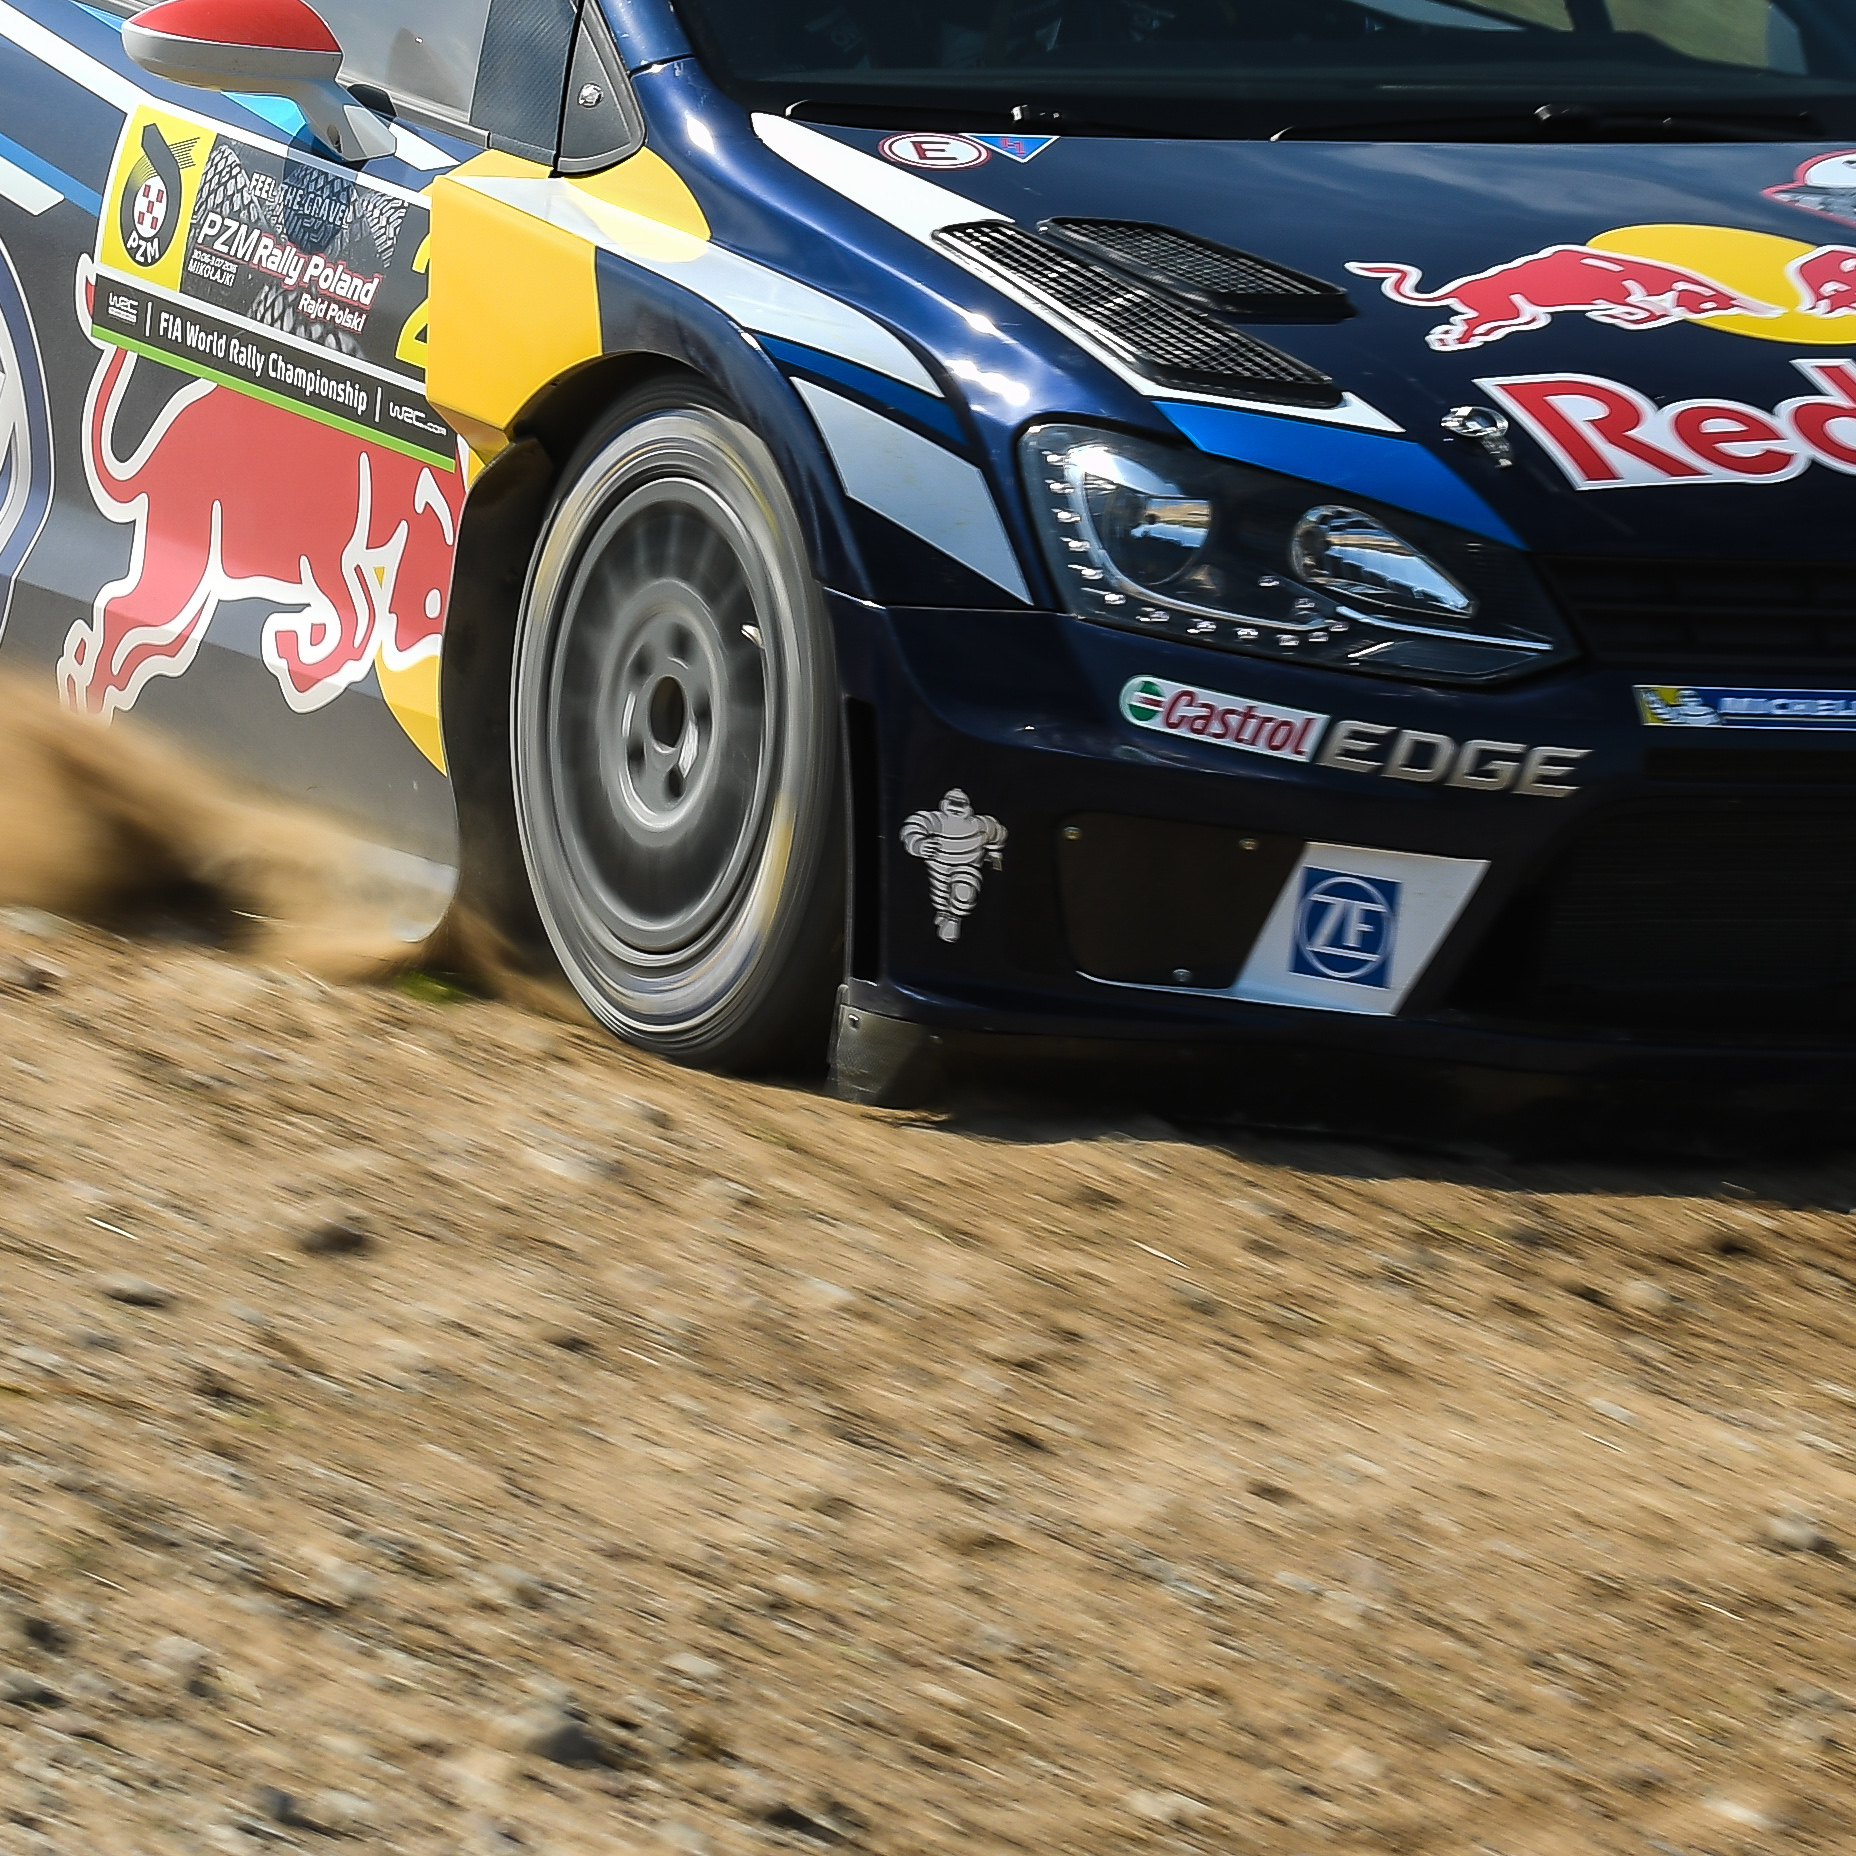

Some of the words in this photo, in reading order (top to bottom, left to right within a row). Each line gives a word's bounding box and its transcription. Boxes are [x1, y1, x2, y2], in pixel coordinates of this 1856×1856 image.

[911, 140, 957, 161] E
[250, 172, 276, 201] FEEL
[278, 182, 304, 211] THE
[126, 230, 160, 264] PZM
[197, 212, 261, 262] PZM
[252, 237, 306, 286] Rally
[303, 254, 381, 305] Poland
[297, 293, 327, 319] Rajd
[326, 307, 366, 332] Polski
[158, 313, 182, 342] FIA
[186, 321, 227, 358] World
[229, 335, 265, 377] Rally
[268, 352, 368, 414] Championship
[1163, 687, 1318, 760] Castrol
[1314, 720, 1593, 798] EDGE
[1302, 892, 1389, 963] ZF
